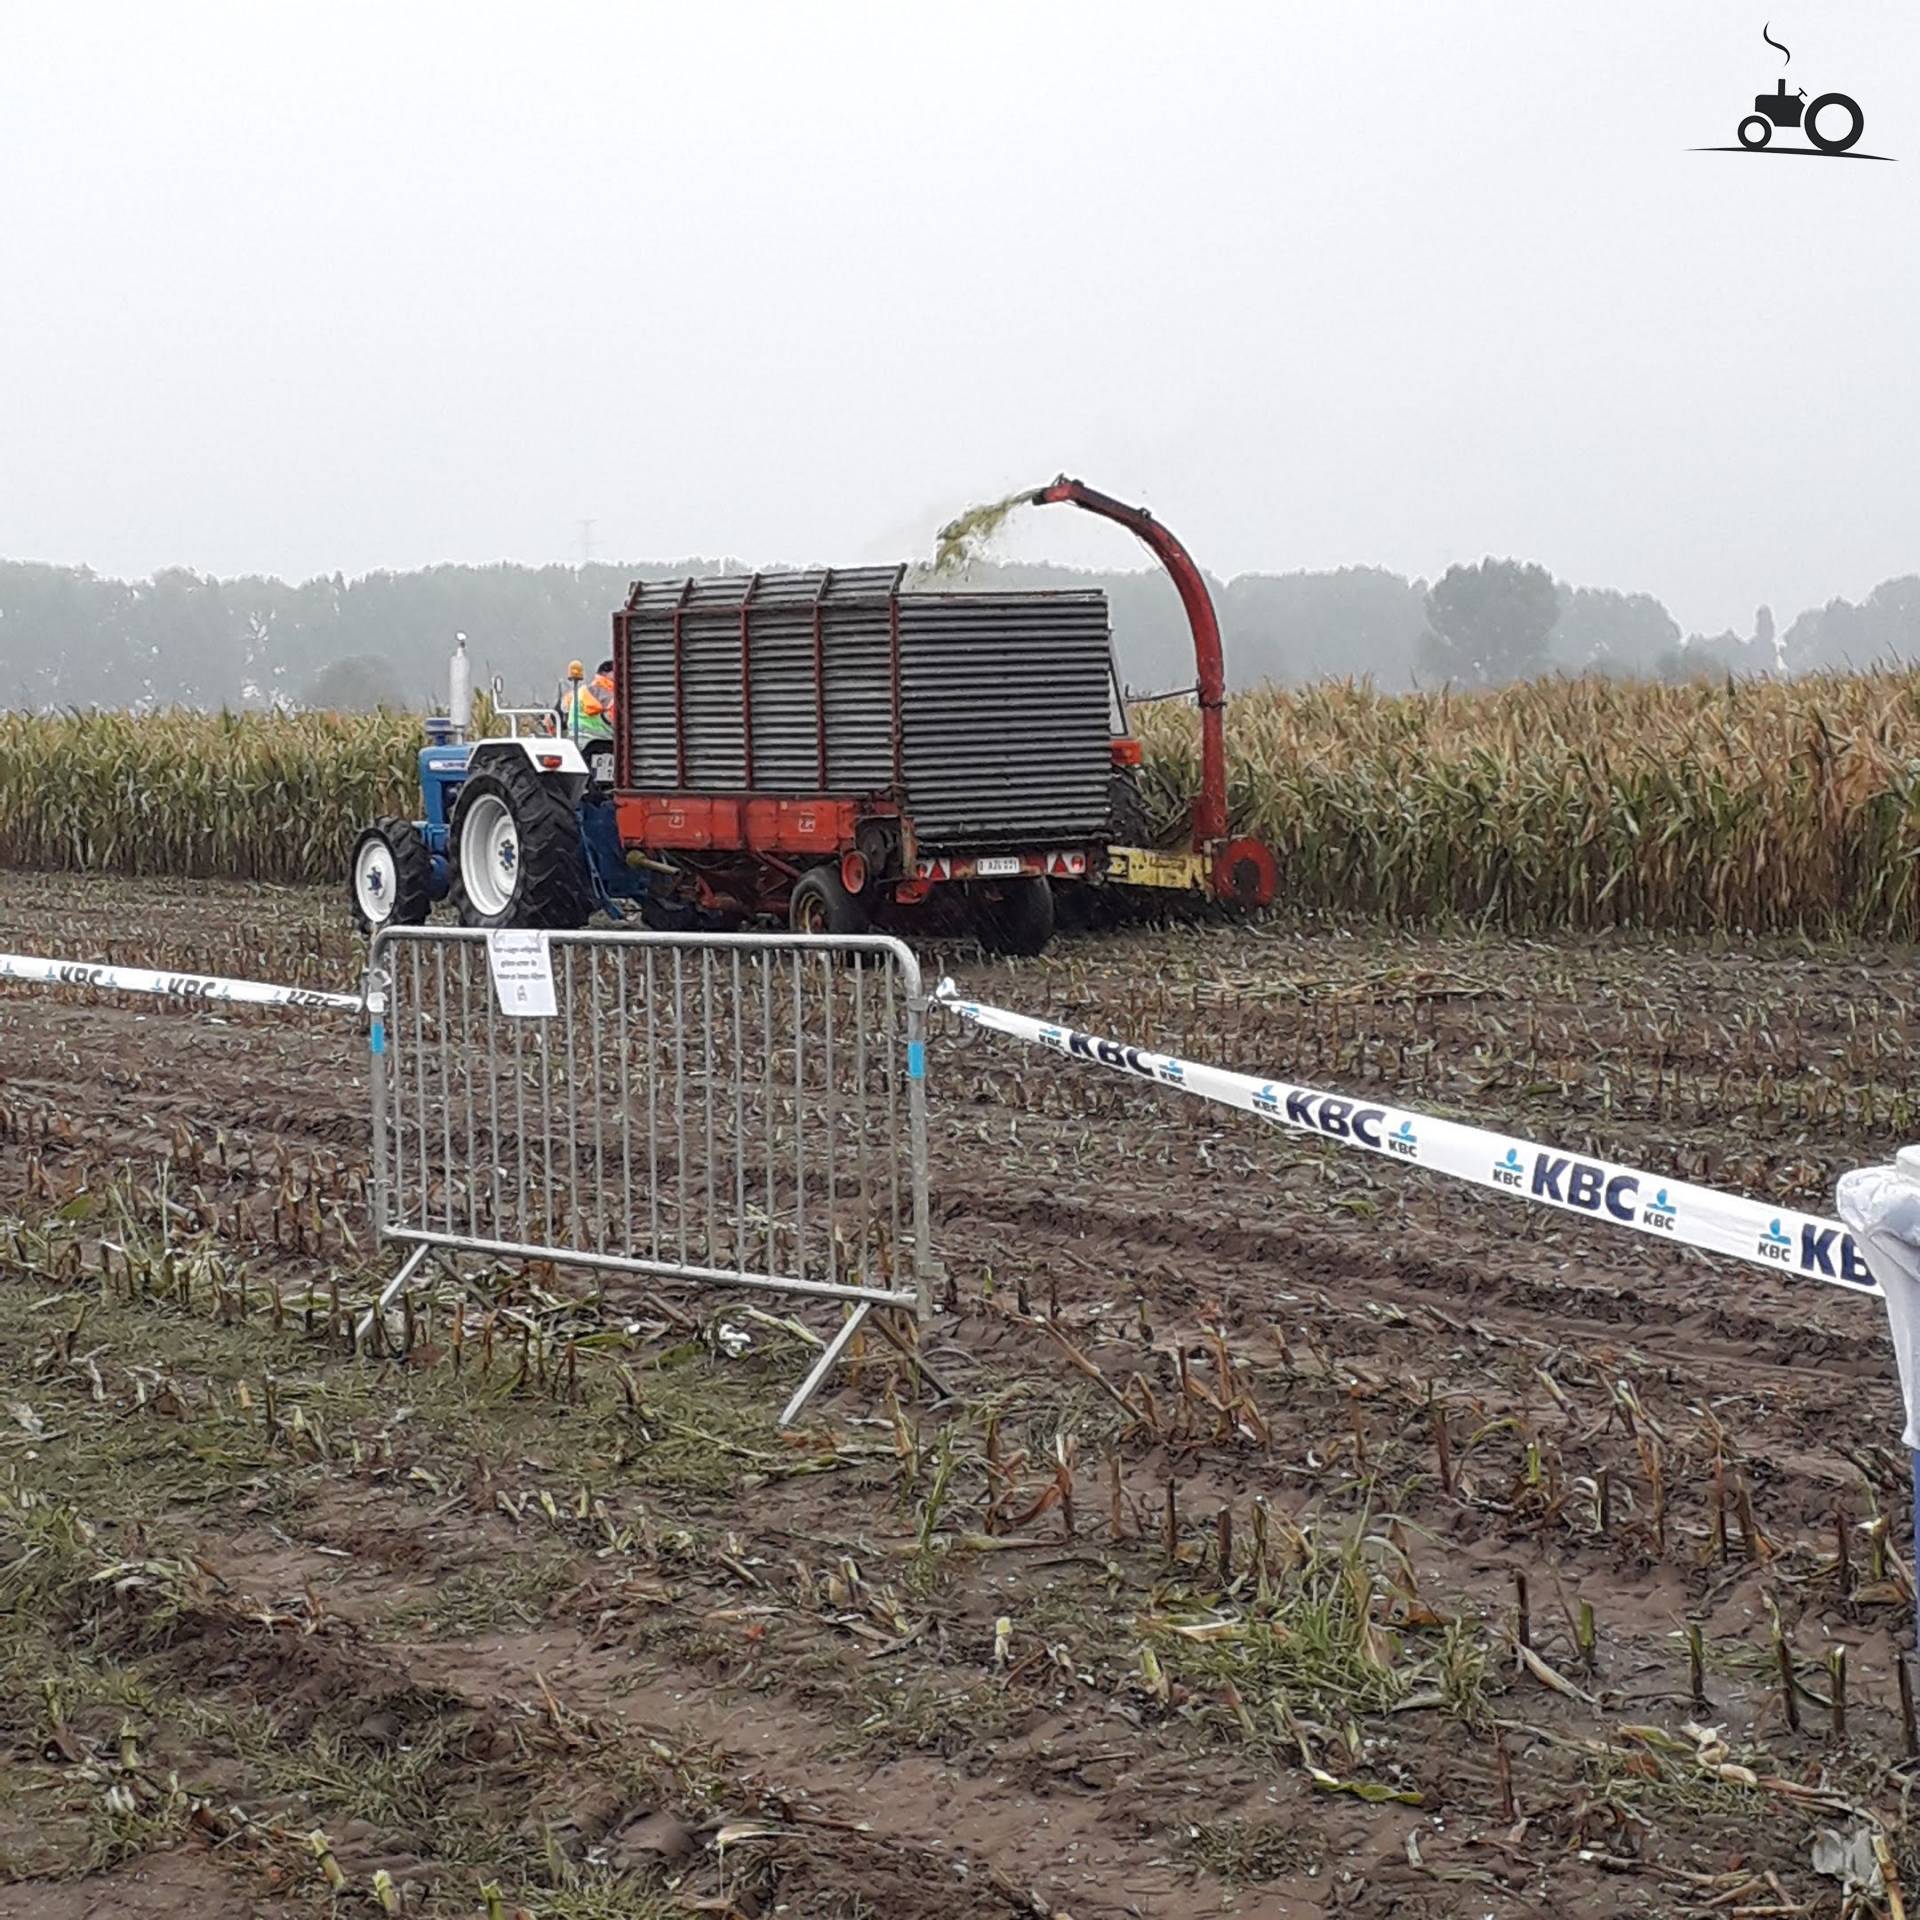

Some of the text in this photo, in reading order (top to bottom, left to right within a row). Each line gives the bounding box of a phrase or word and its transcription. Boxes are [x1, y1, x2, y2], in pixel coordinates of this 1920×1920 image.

[1069, 1034, 1155, 1078] KBC
[1159, 1070, 1187, 1087] KBC
[1254, 1098, 1280, 1116] KBC
[1286, 1090, 1387, 1148] KBC
[1388, 1139, 1418, 1158] KBC
[1492, 1169, 1523, 1188] KBC
[1531, 1153, 1641, 1221] KBC
[1642, 1210, 1675, 1231] KBC
[1757, 1242, 1791, 1263] KBC
[1800, 1223, 1877, 1287] KB
